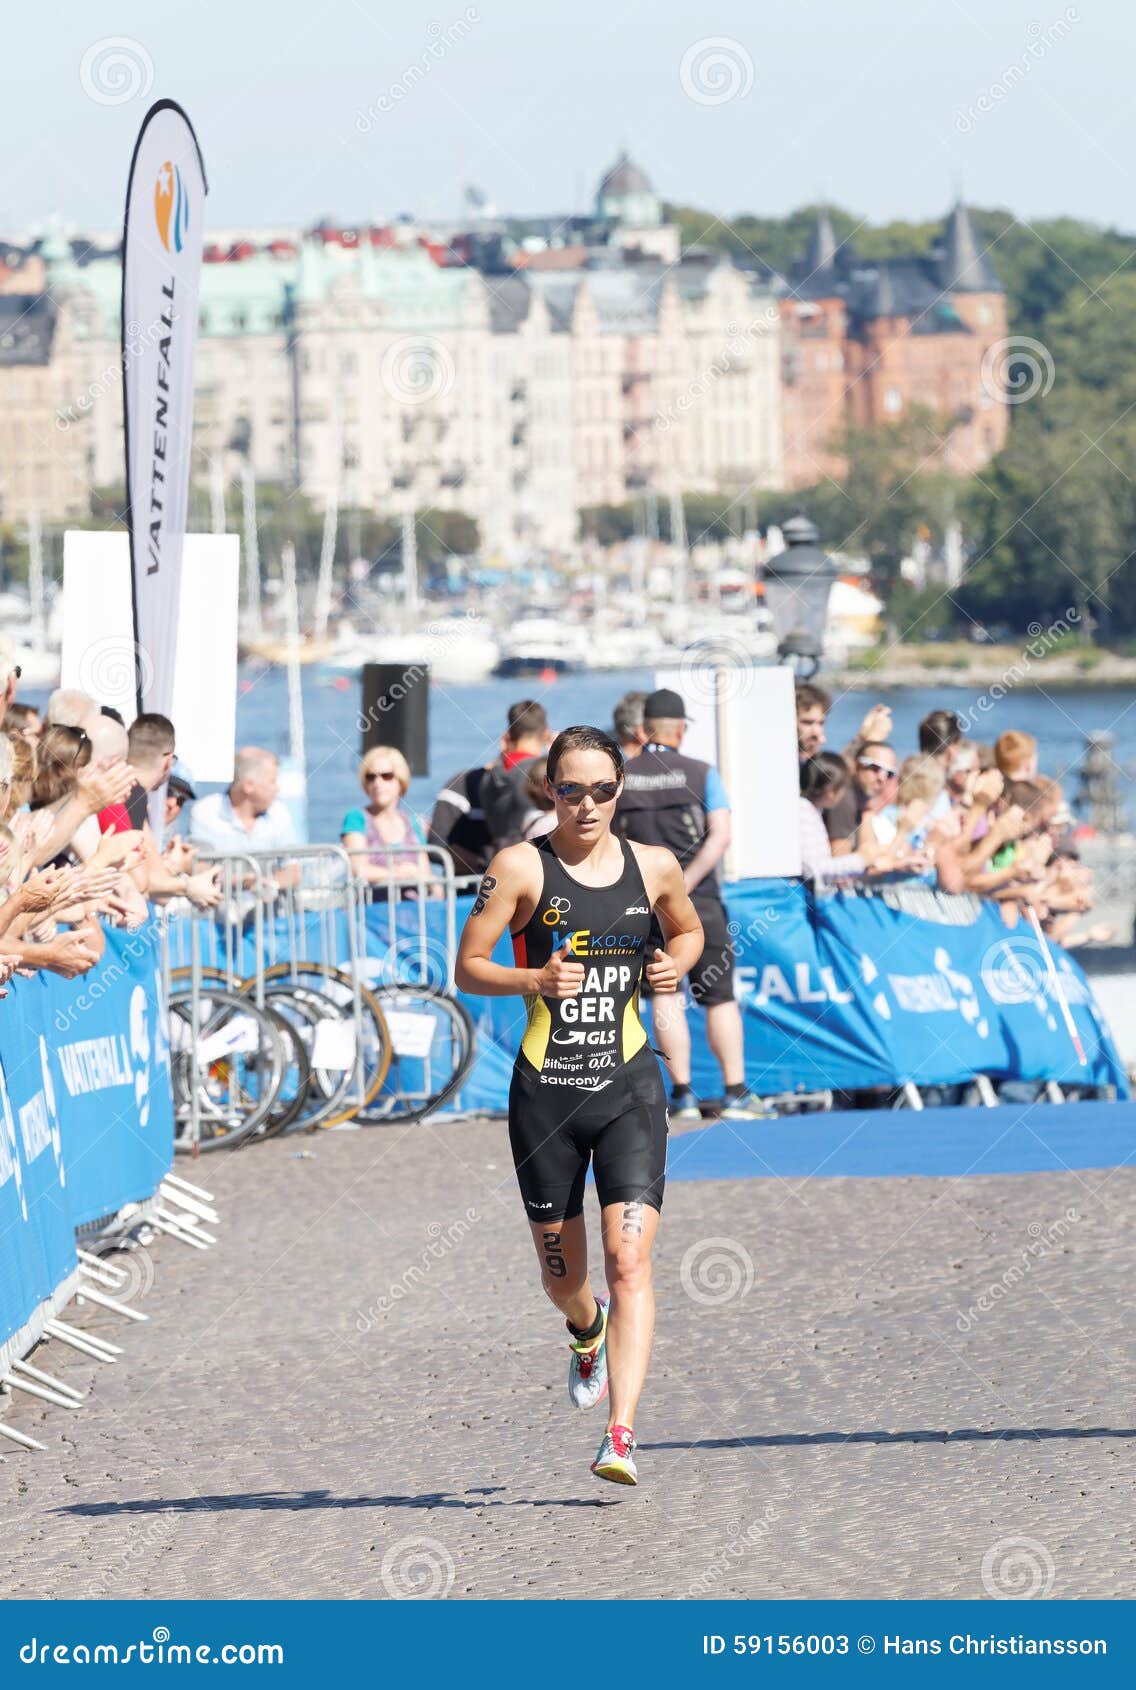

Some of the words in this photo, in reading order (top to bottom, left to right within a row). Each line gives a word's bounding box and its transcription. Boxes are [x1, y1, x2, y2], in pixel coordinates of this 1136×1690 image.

[147, 276, 175, 577] VATTENFALL
[591, 935, 642, 948] KOCH
[577, 966, 631, 993] APP
[560, 996, 616, 1023] GER
[587, 1030, 617, 1045] GLS
[543, 1058, 584, 1071] Bitburger
[540, 1075, 600, 1086] saucony
[543, 1232, 567, 1278] 29
